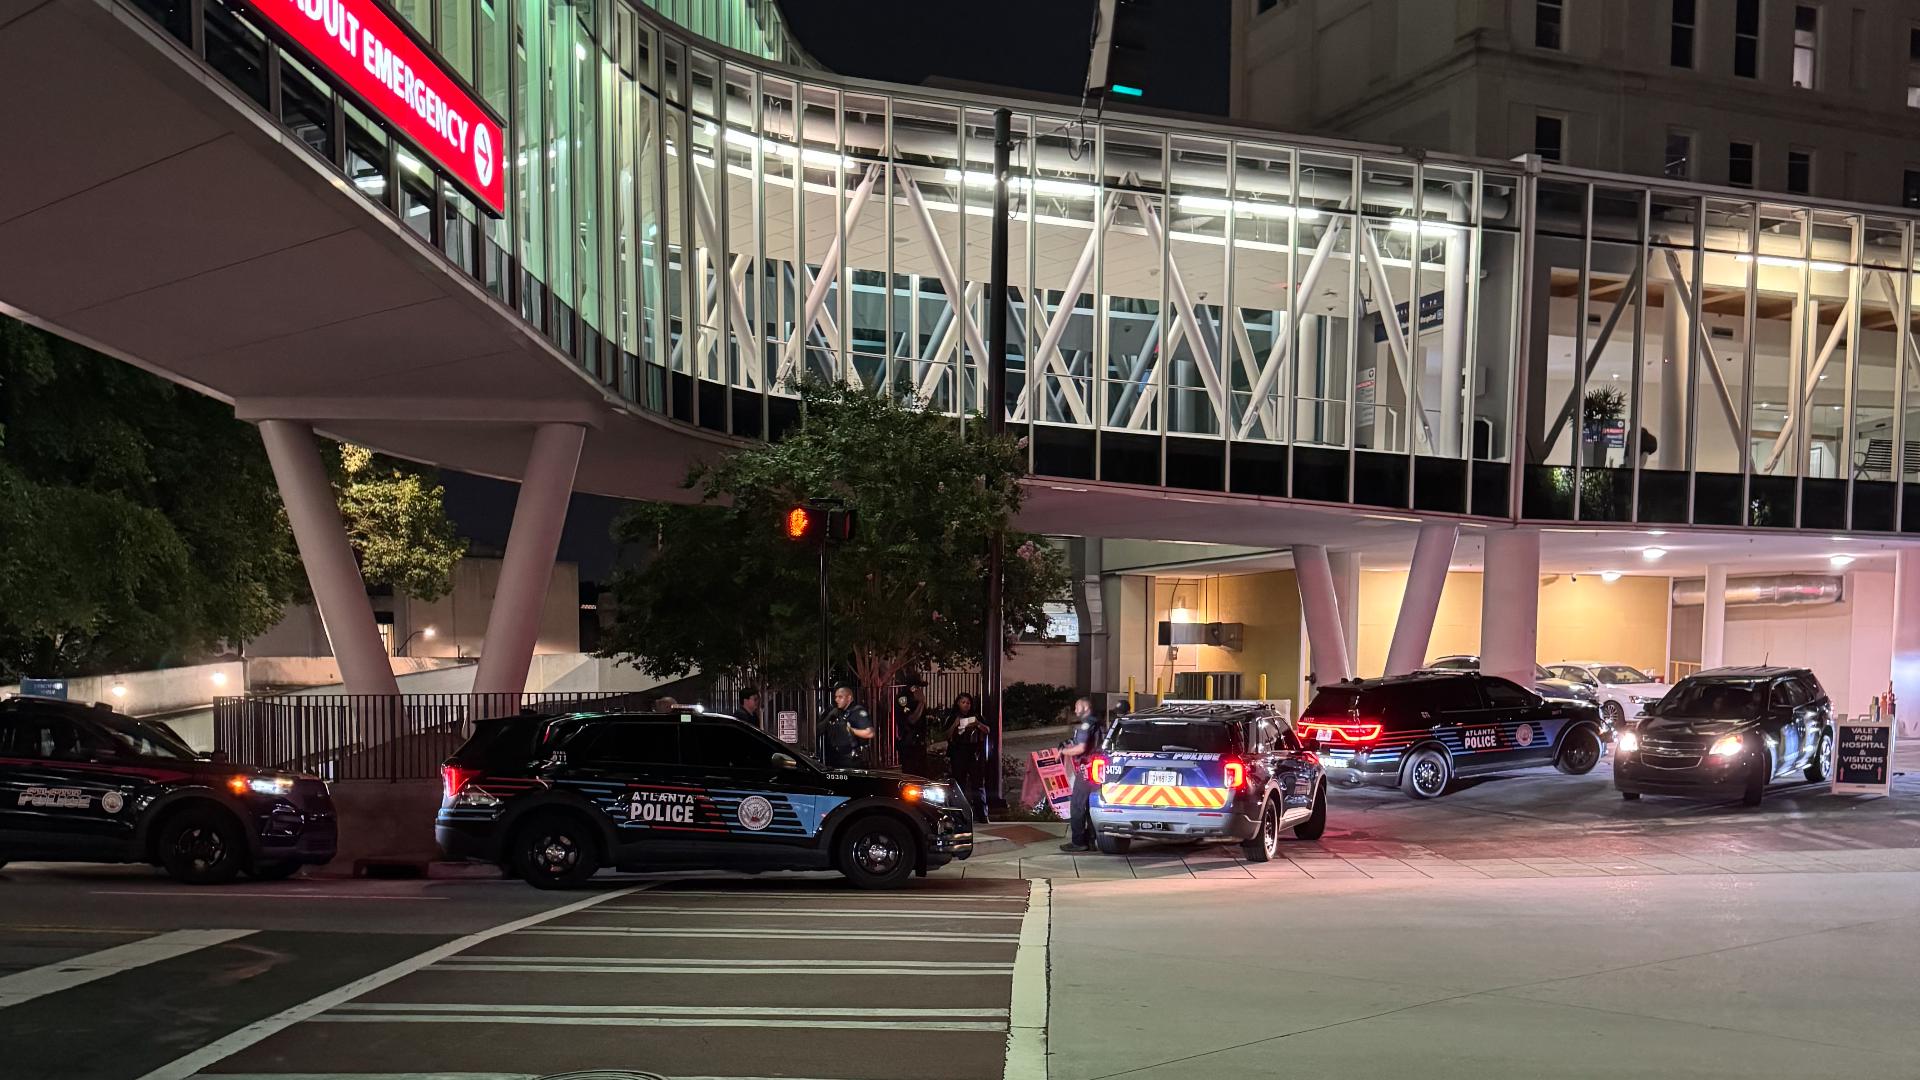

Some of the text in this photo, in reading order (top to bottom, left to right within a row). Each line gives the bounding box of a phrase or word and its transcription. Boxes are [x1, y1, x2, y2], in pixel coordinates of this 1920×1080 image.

[289, 0, 468, 153] ULT EMERGENCY
[1465, 735, 1497, 749] POLICE
[632, 791, 694, 803] ATLANTA
[630, 802, 694, 823] POLICE
